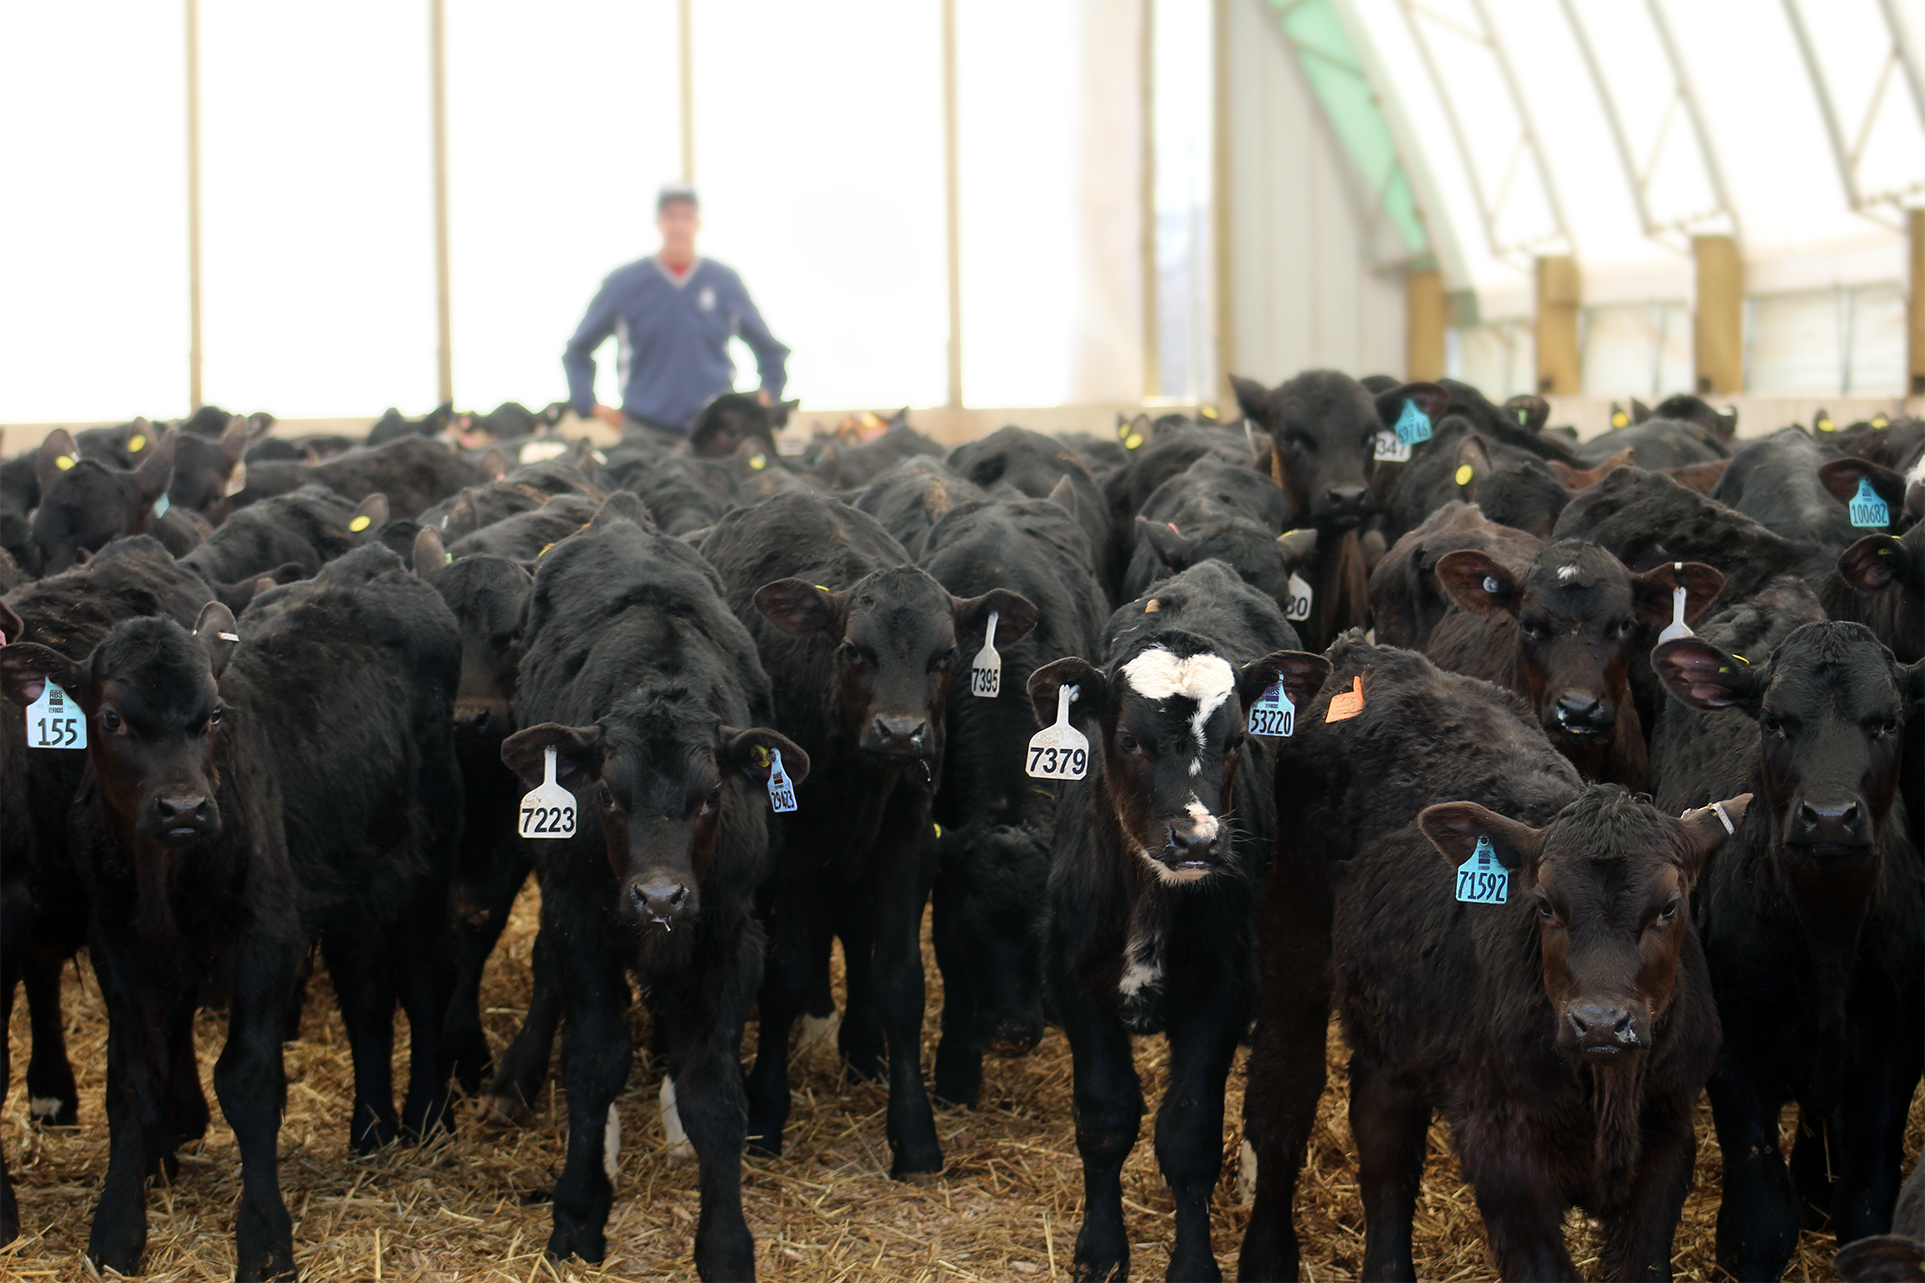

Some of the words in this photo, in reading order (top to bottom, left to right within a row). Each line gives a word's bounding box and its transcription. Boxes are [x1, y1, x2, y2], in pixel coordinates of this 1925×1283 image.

[1851, 503, 1888, 524] 100682
[973, 668, 998, 692] 7395
[37, 718, 78, 747] 155
[1250, 709, 1291, 735] 53220
[1030, 747, 1087, 775] 7379
[522, 807, 575, 833] 7223
[1458, 871, 1507, 902] 71592
